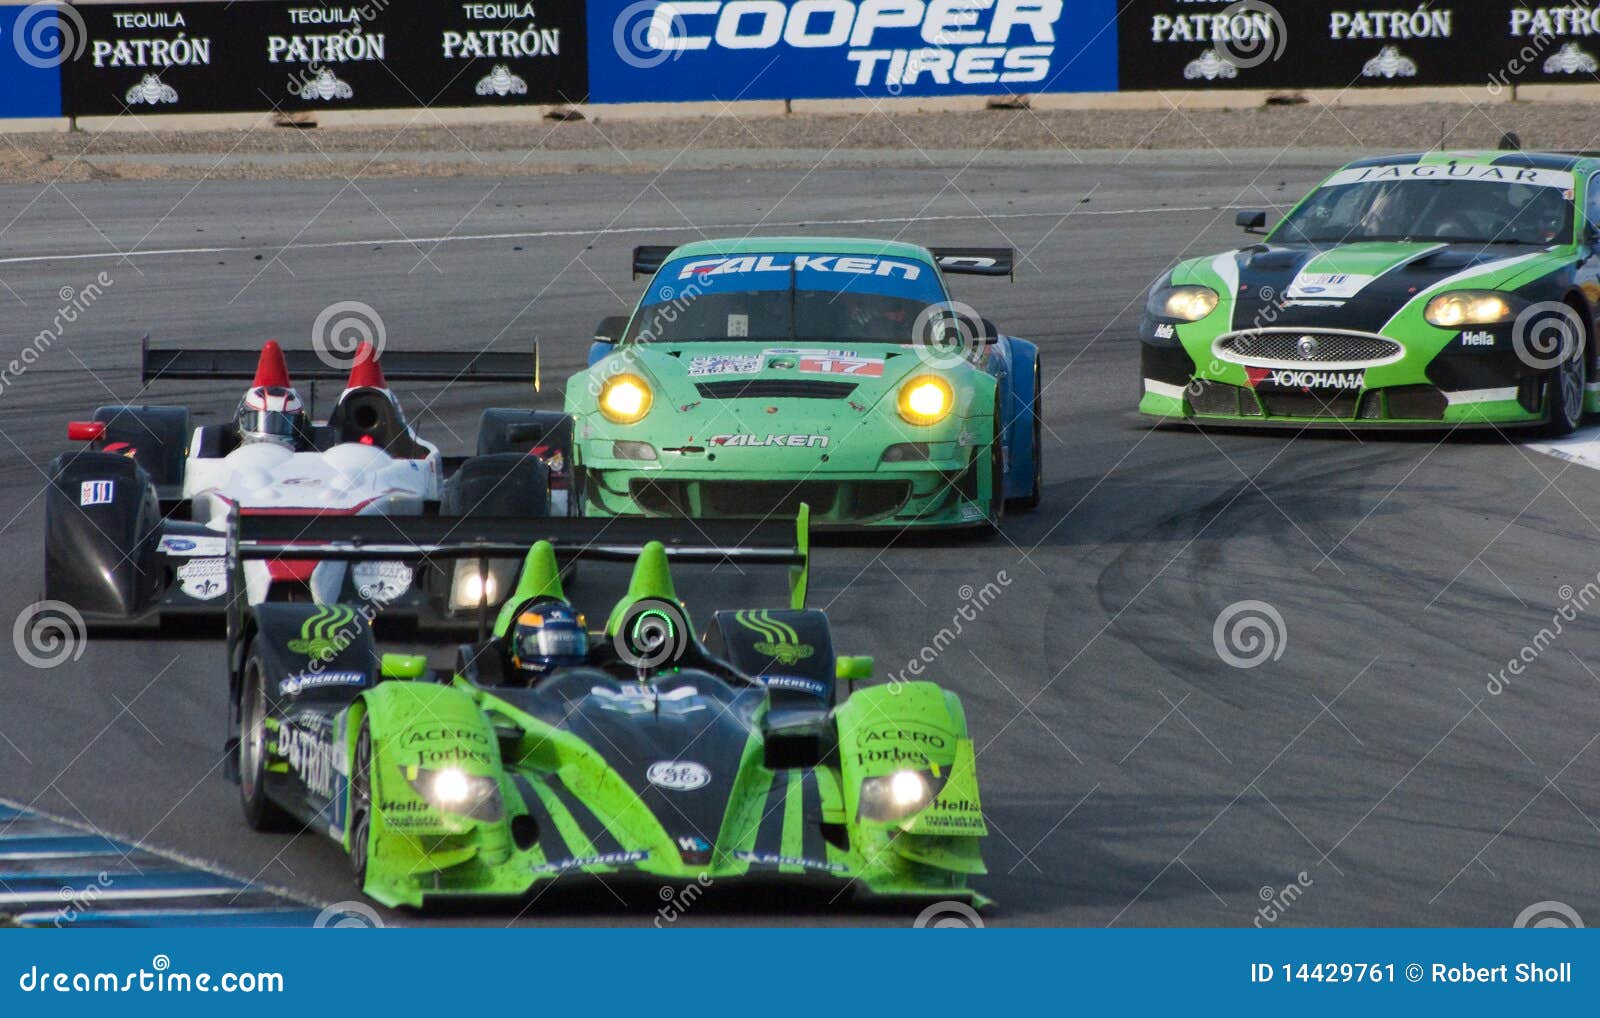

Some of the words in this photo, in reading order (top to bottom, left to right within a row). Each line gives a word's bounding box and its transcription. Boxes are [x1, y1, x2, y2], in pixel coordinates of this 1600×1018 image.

[113, 12, 186, 28] TEQUILA
[288, 8, 361, 24] TEQUILA
[463, 3, 535, 19] TEQUILA
[647, 0, 1062, 50] COOPER
[1151, 7, 1273, 42] PATRÓN
[1329, 4, 1451, 39] PATRÓN
[93, 31, 211, 67] PATRÓN
[267, 27, 385, 62] PATRÓN
[442, 23, 560, 58] PATRÓN
[847, 46, 1054, 86] TIRES
[1355, 164, 1538, 183] JAGUAR
[678, 255, 921, 281] FALKEN
[1462, 330, 1494, 346] Hella
[814, 359, 869, 374] 17
[1272, 370, 1367, 389] YOKOHAMA
[708, 434, 829, 448] FALKEN
[301, 674, 361, 686] MICHELIN
[768, 676, 823, 692] MICHELIN
[865, 730, 945, 748] ACERO
